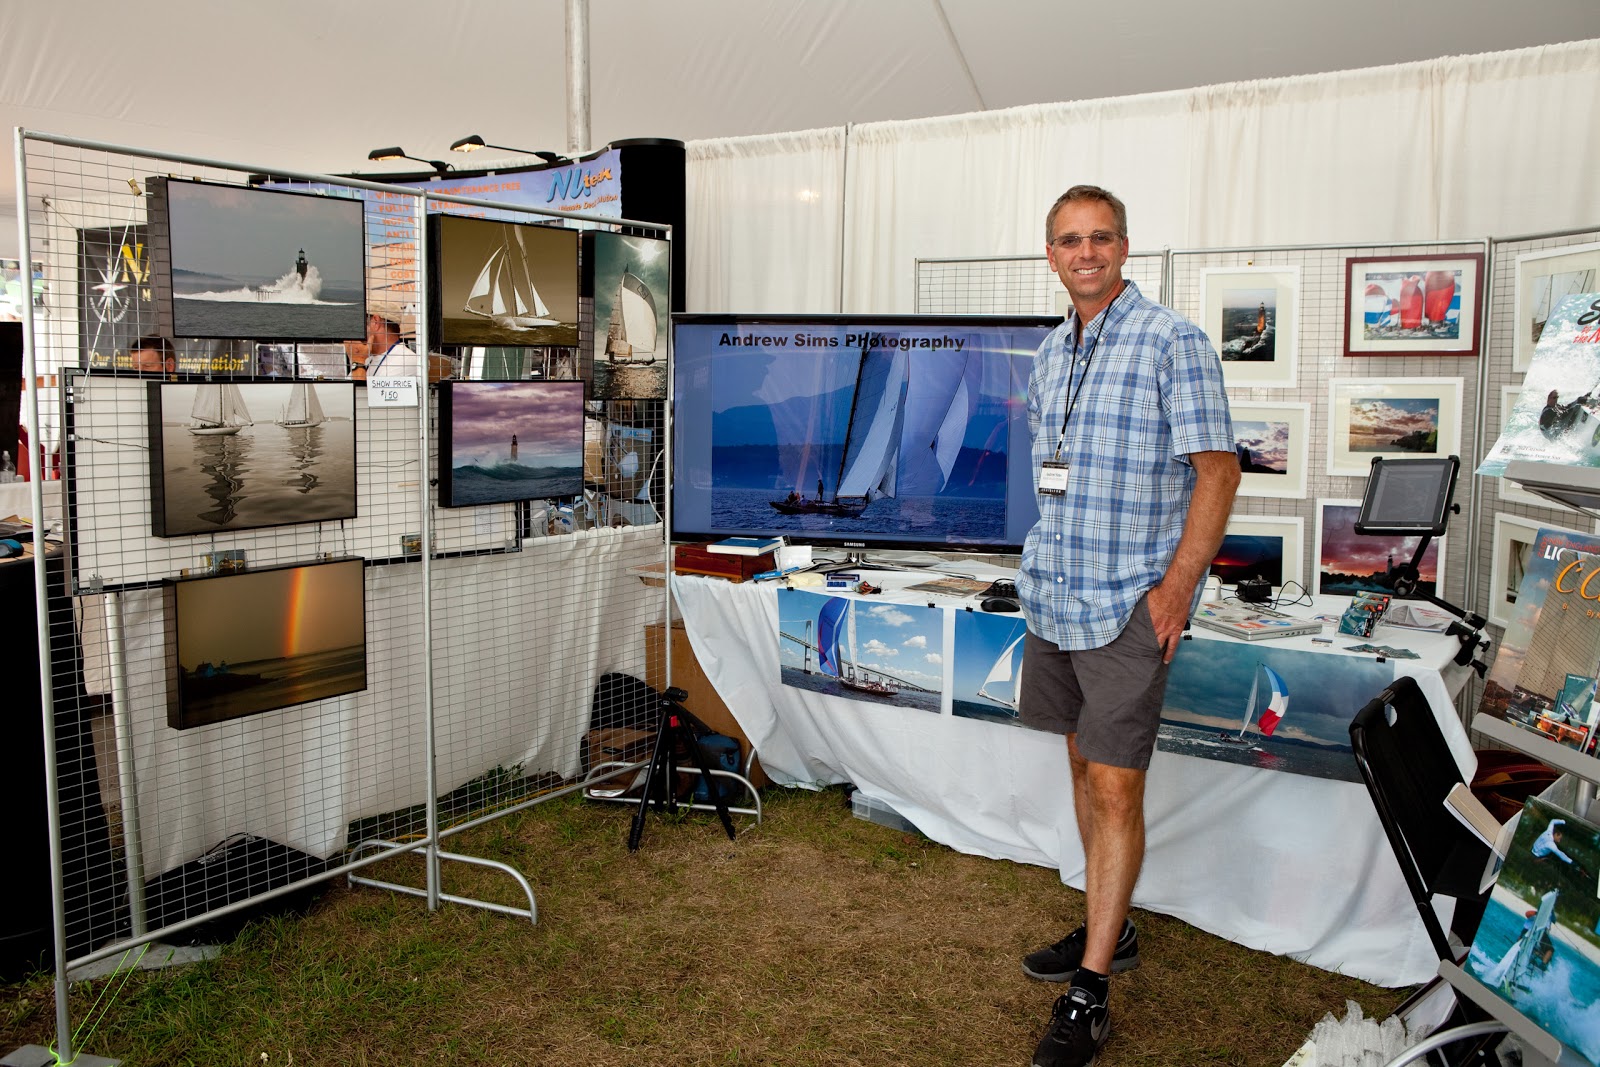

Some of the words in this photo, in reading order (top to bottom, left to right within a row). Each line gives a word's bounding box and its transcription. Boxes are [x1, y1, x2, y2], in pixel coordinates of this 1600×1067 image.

[501, 182, 521, 192] FREE
[719, 333, 788, 347] Andrew
[794, 333, 839, 348] Sims
[845, 333, 965, 352] Photography
[372, 380, 391, 388] SHOW
[393, 380, 412, 388] PRICE
